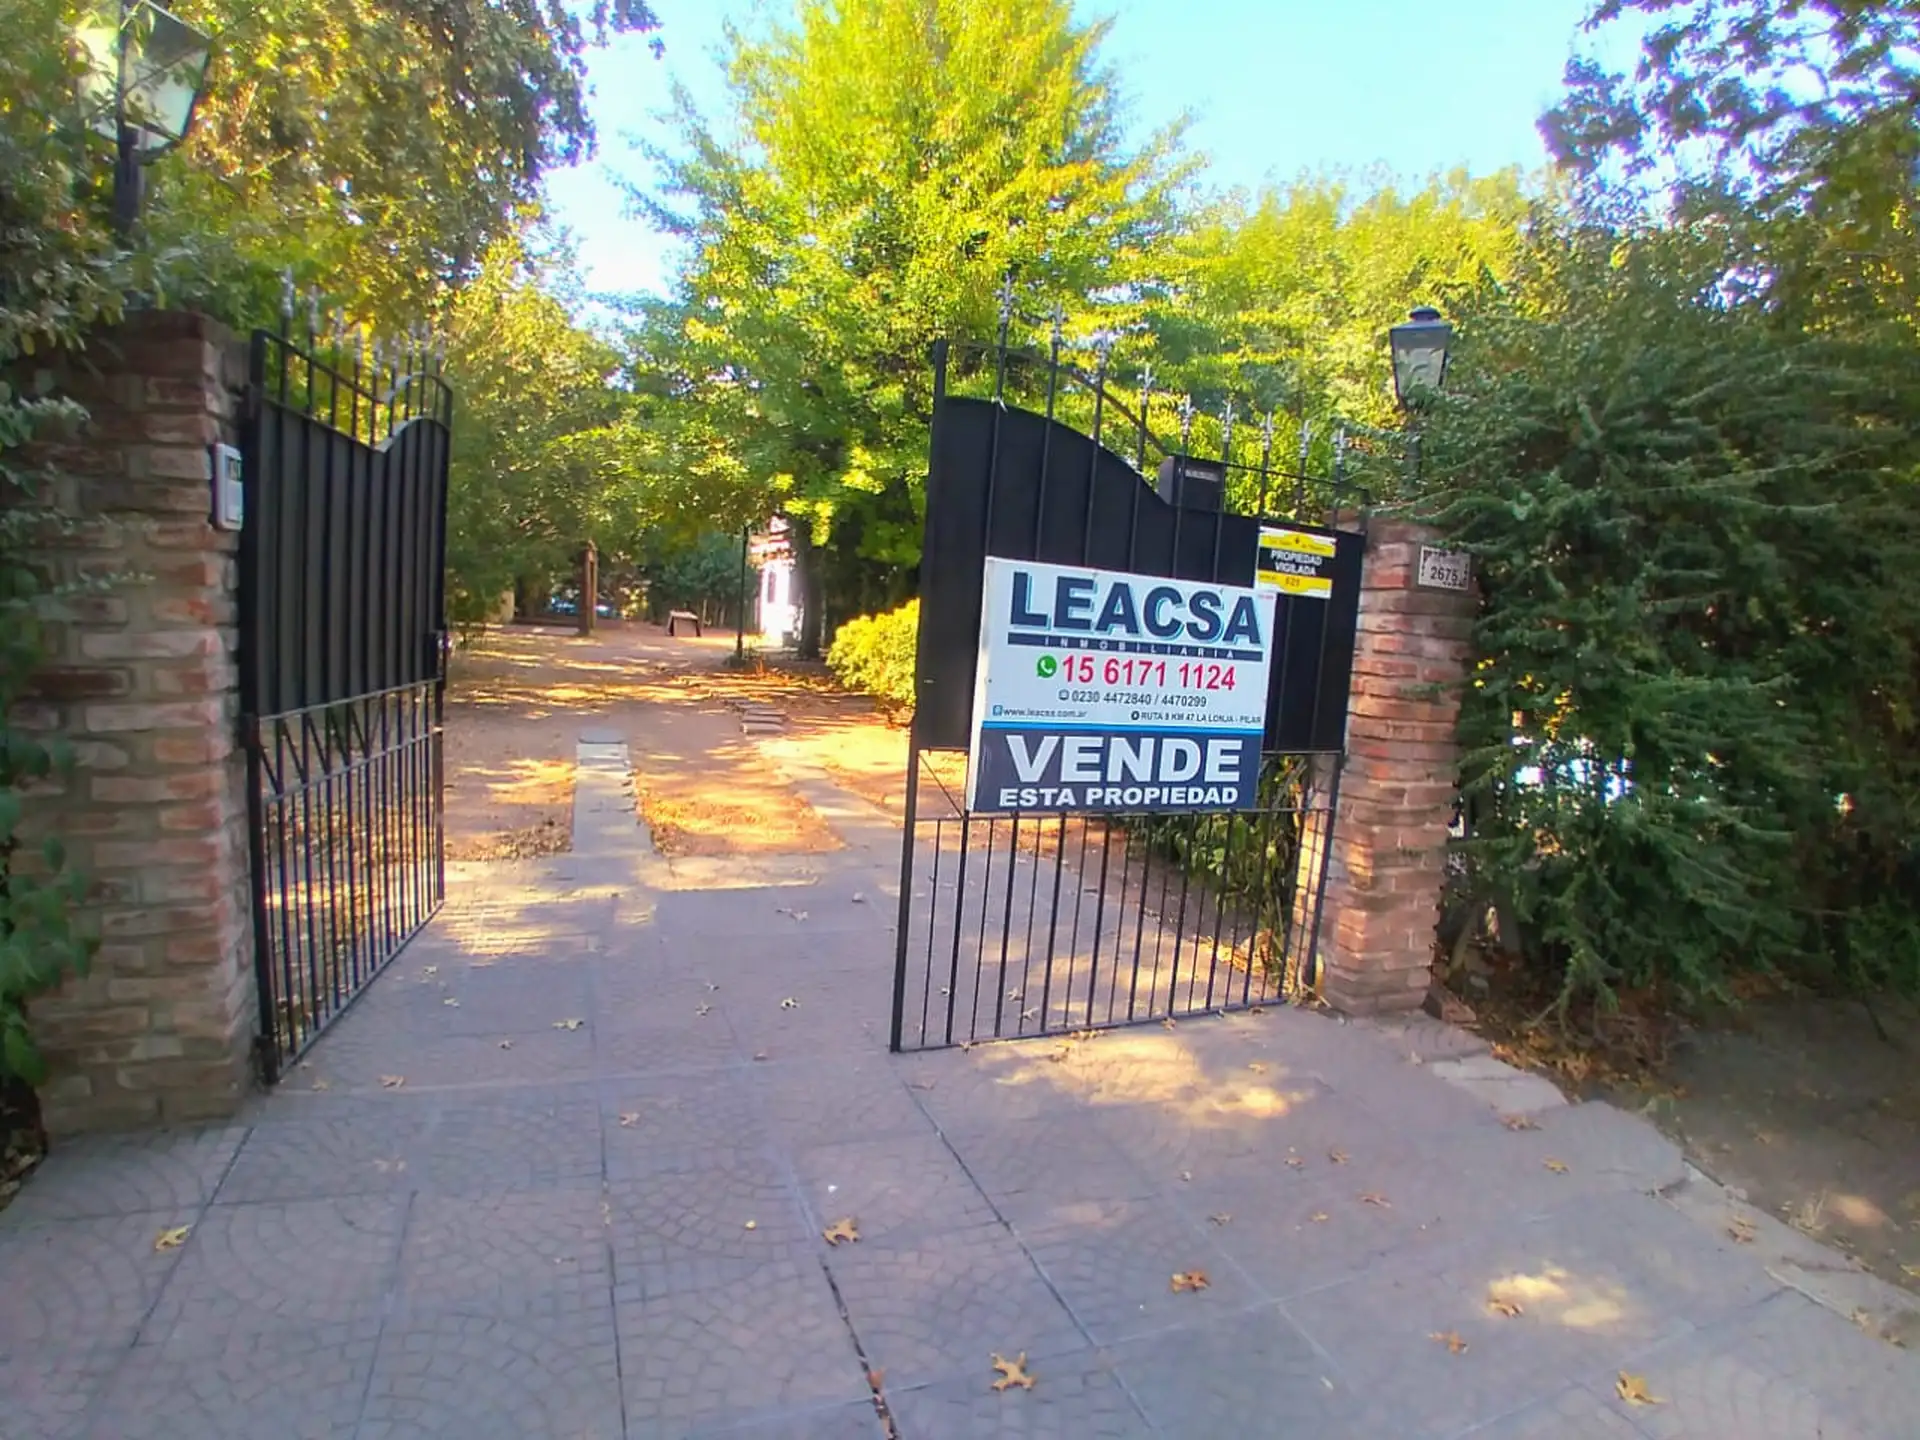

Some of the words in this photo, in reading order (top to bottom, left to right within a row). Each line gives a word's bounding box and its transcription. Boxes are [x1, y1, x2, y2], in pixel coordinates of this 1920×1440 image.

[1270, 549, 1322, 566] PROPIEDAD
[1275, 562, 1316, 576] VIGILADA
[1430, 566, 1458, 582] 2675
[1009, 571, 1263, 646] LEACSA
[1043, 636, 1235, 659] INMOBILIARIA
[1062, 654, 1095, 683] 15
[1103, 657, 1166, 688] 6171
[1178, 662, 1236, 691] 1124
[1071, 689, 1100, 703] 0230
[1103, 691, 1152, 706] 4472840
[1161, 695, 1207, 708] 4470299
[1141, 711, 1163, 721] RUTA
[1006, 735, 1243, 783] VENDE
[999, 788, 1077, 807] ESTA
[1086, 786, 1239, 806] PROPIEDAD
